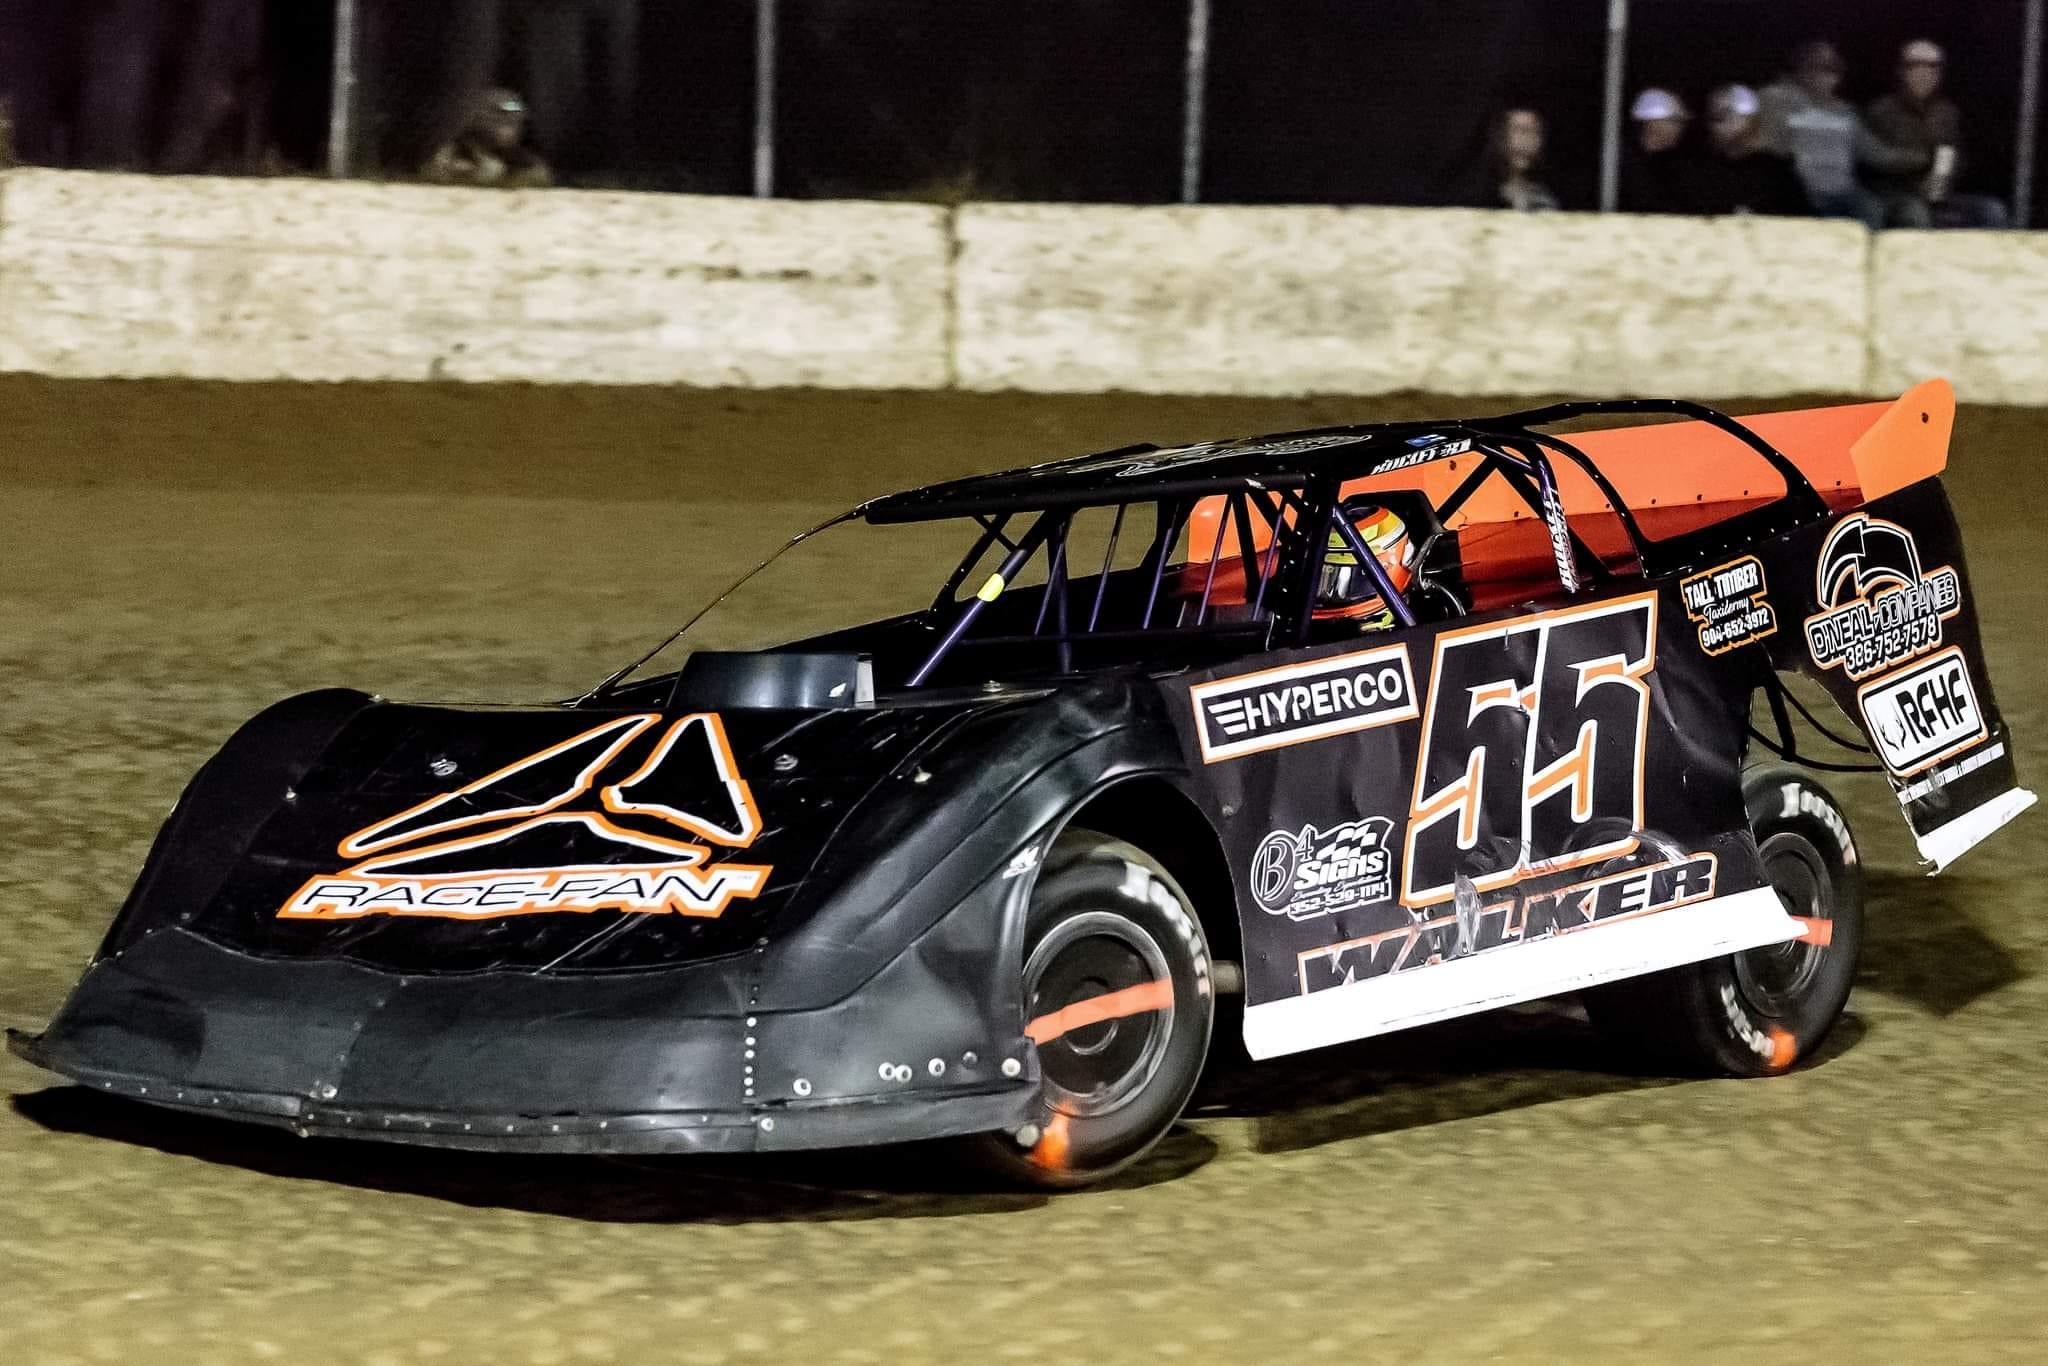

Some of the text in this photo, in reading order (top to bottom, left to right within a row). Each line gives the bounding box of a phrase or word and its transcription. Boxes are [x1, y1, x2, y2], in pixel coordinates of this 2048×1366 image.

[1685, 563, 1759, 610] TALL TIMBER
[1703, 597, 1750, 625] Taxidermy
[1702, 608, 1770, 647] 904-652-3972
[1846, 614, 1937, 670] 386-752-7578
[1244, 668, 1401, 730] HYPERCO
[1402, 596, 1657, 903] 55
[299, 873, 728, 908] RACE-FAN
[1298, 853, 1716, 995] WALKER
